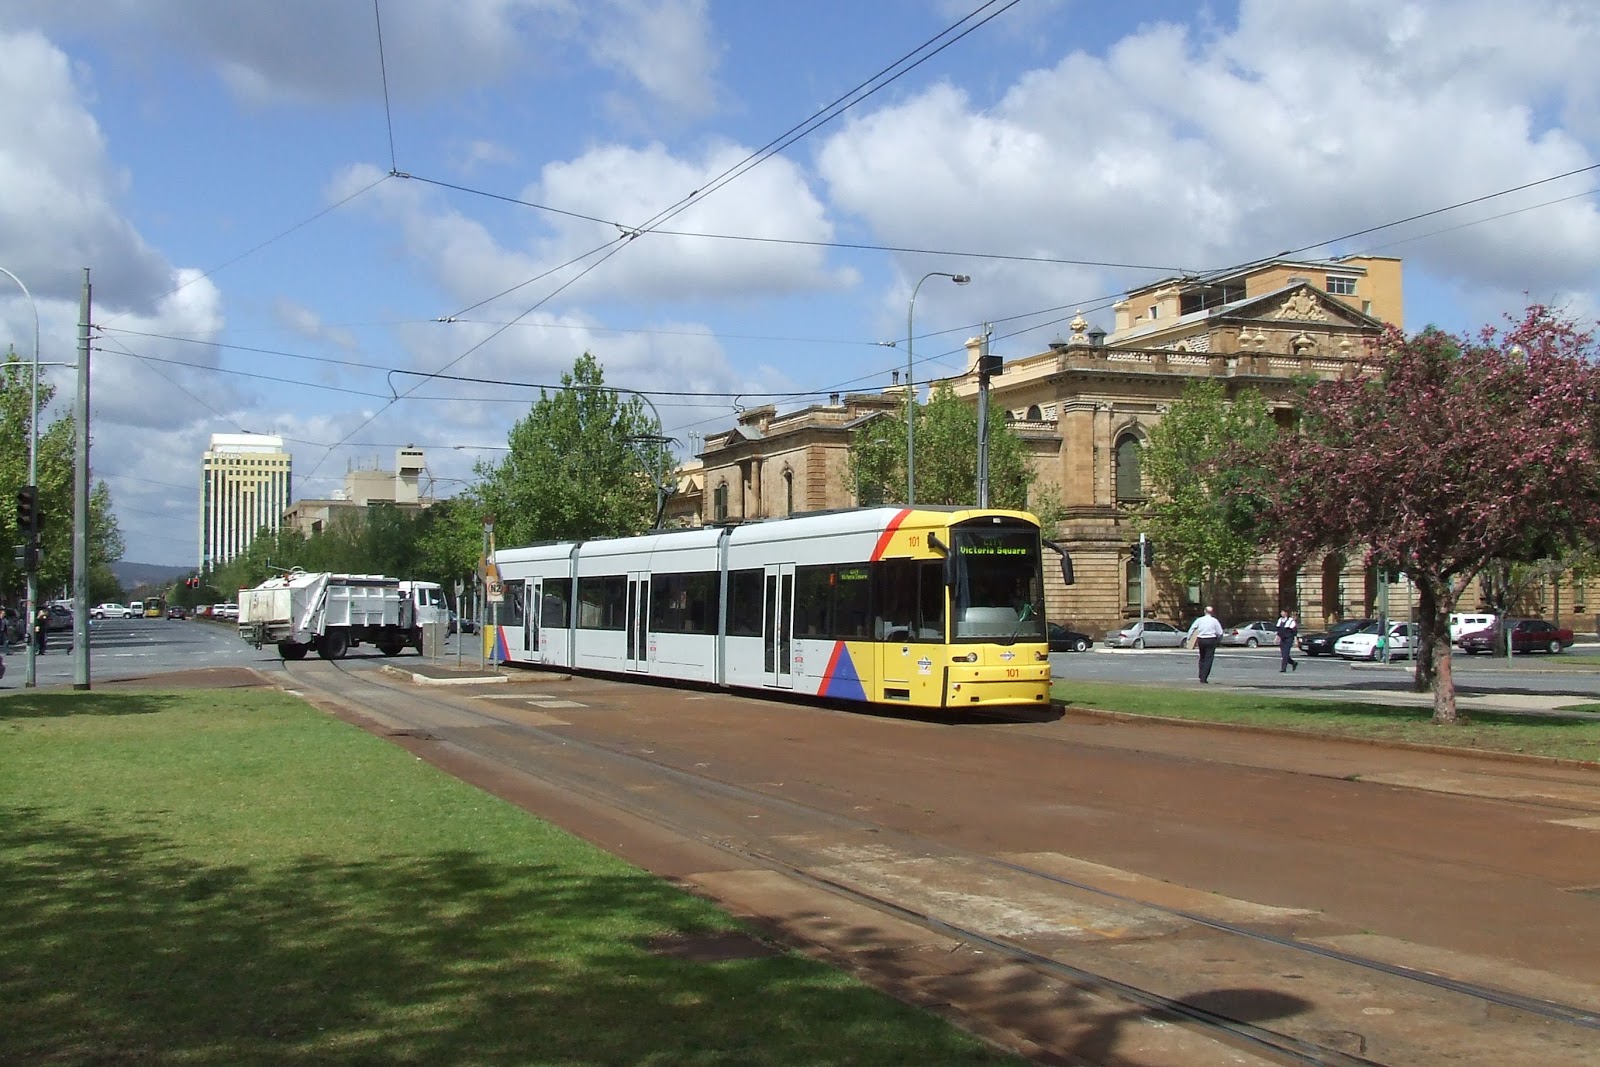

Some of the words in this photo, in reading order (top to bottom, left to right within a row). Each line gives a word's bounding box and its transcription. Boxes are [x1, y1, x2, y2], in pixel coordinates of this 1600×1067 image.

[909, 536, 920, 547] 101
[960, 546, 994, 555] Victoria
[997, 547, 1026, 555] Square
[1006, 668, 1019, 677] 101
